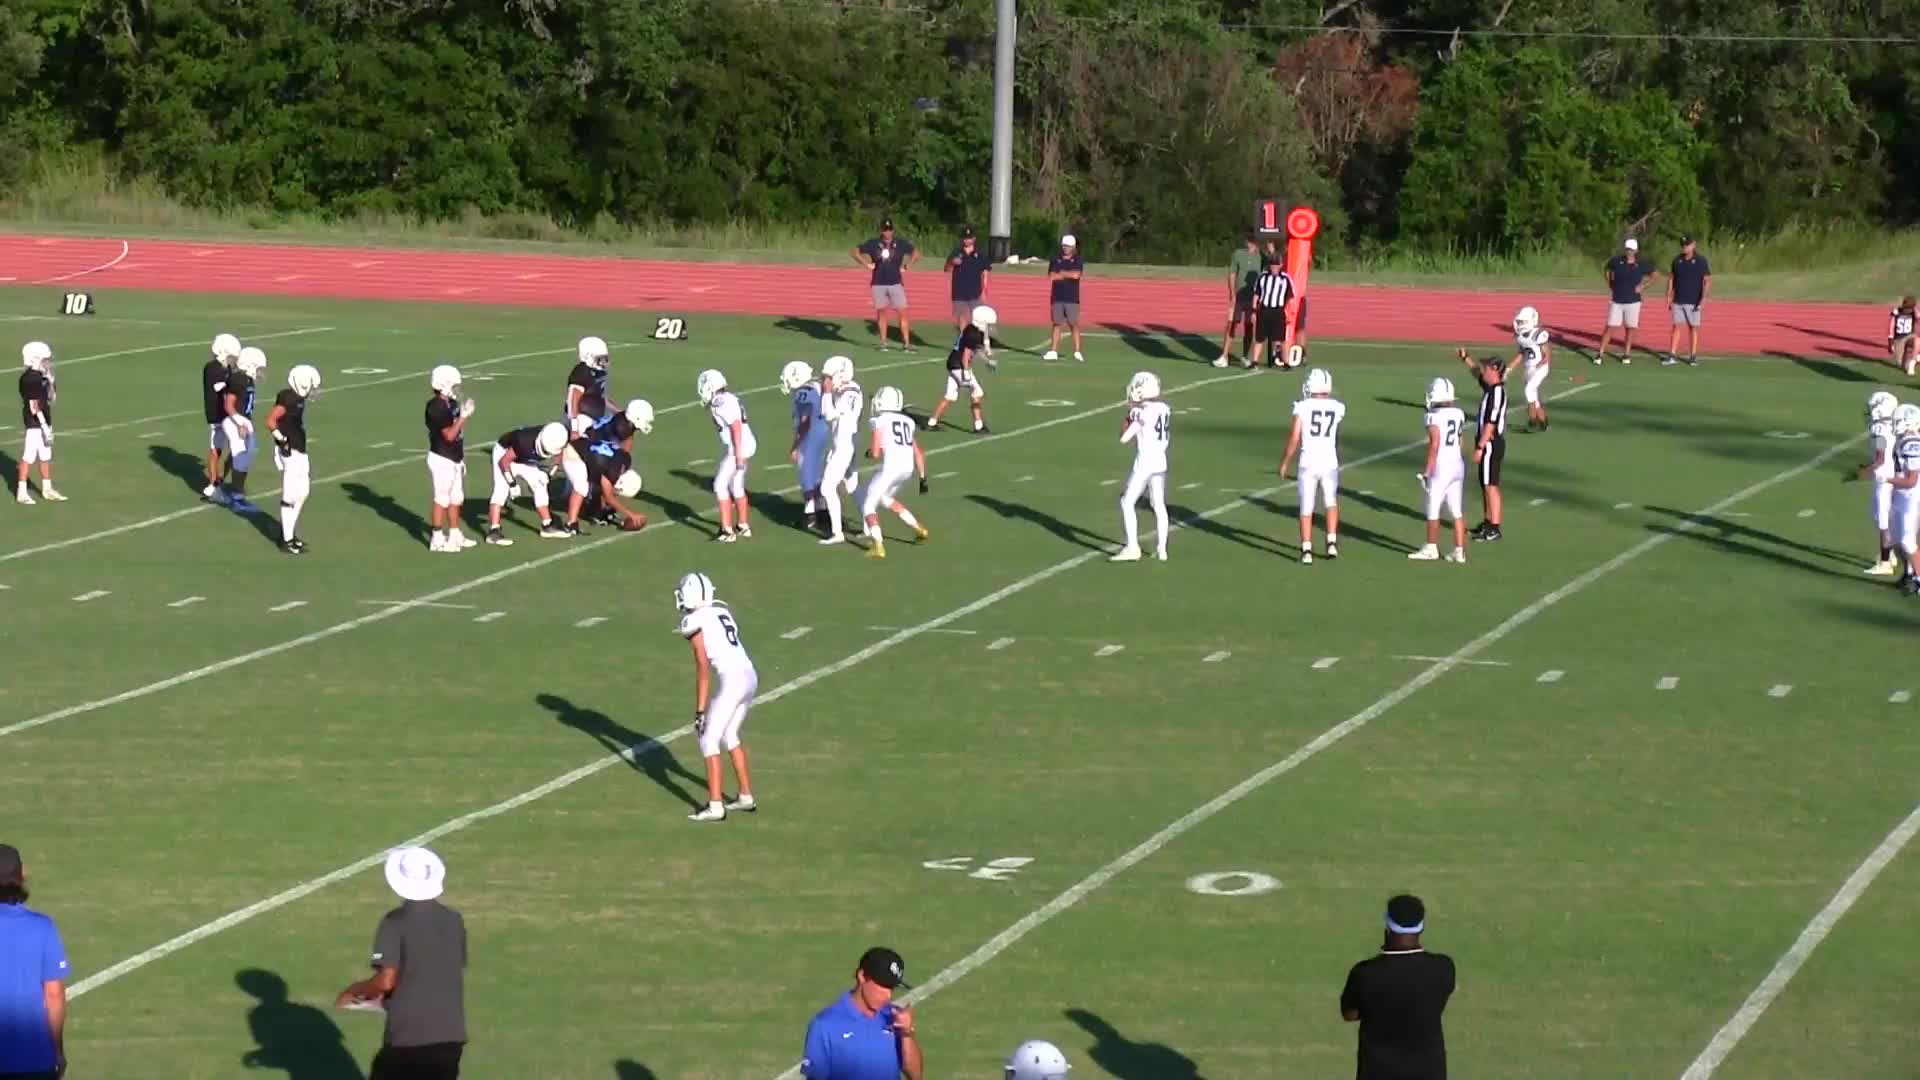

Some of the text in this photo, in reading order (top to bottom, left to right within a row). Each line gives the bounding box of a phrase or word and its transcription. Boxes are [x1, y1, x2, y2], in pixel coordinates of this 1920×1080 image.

[1262, 201, 1276, 229] 1
[65, 293, 88, 315] 10
[655, 318, 682, 339] 20
[891, 420, 914, 446] 50
[1309, 409, 1336, 438] 57
[717, 613, 739, 647] 6
